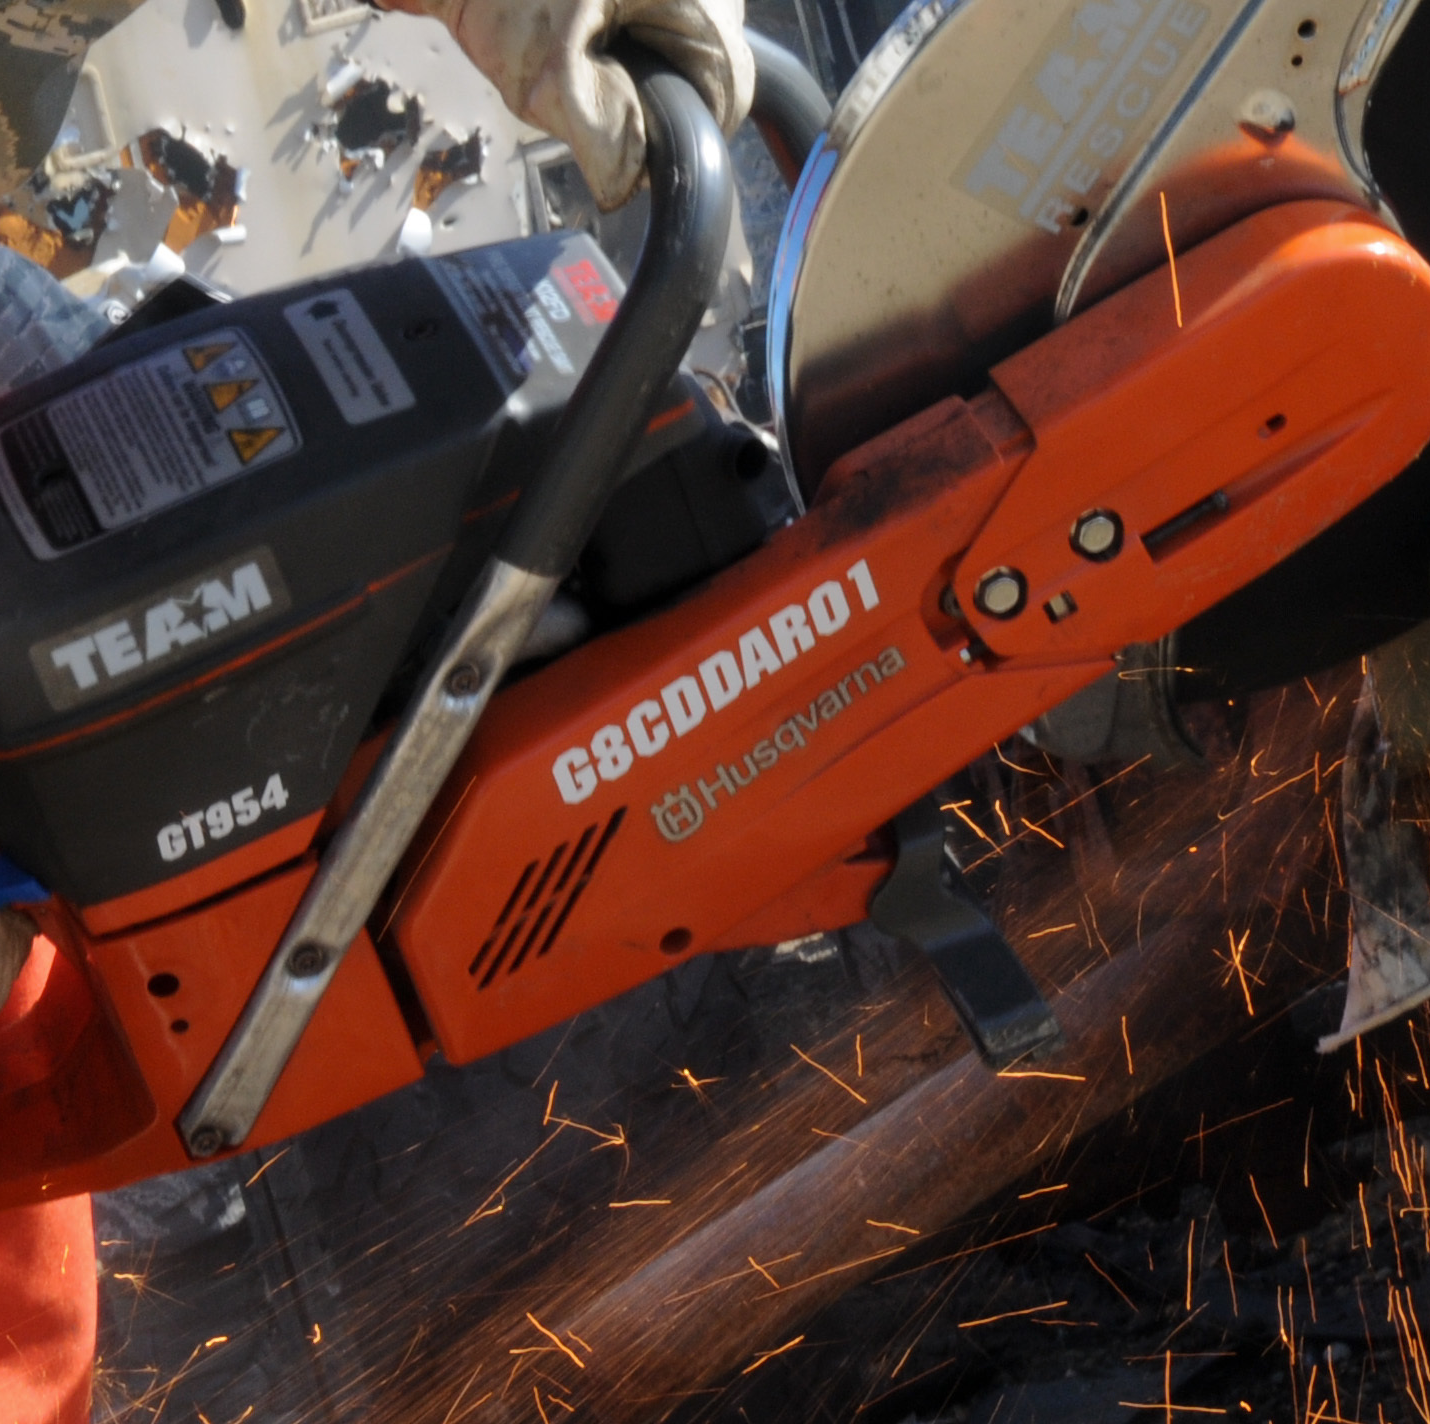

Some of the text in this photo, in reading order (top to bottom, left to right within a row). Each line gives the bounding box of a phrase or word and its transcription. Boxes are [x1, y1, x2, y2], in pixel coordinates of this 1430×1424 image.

[1034, 0, 1208, 236] RESCUE
[51, 561, 272, 690] TEAM
[696, 645, 907, 810] Husqvarna
[157, 773, 290, 863] GT954
